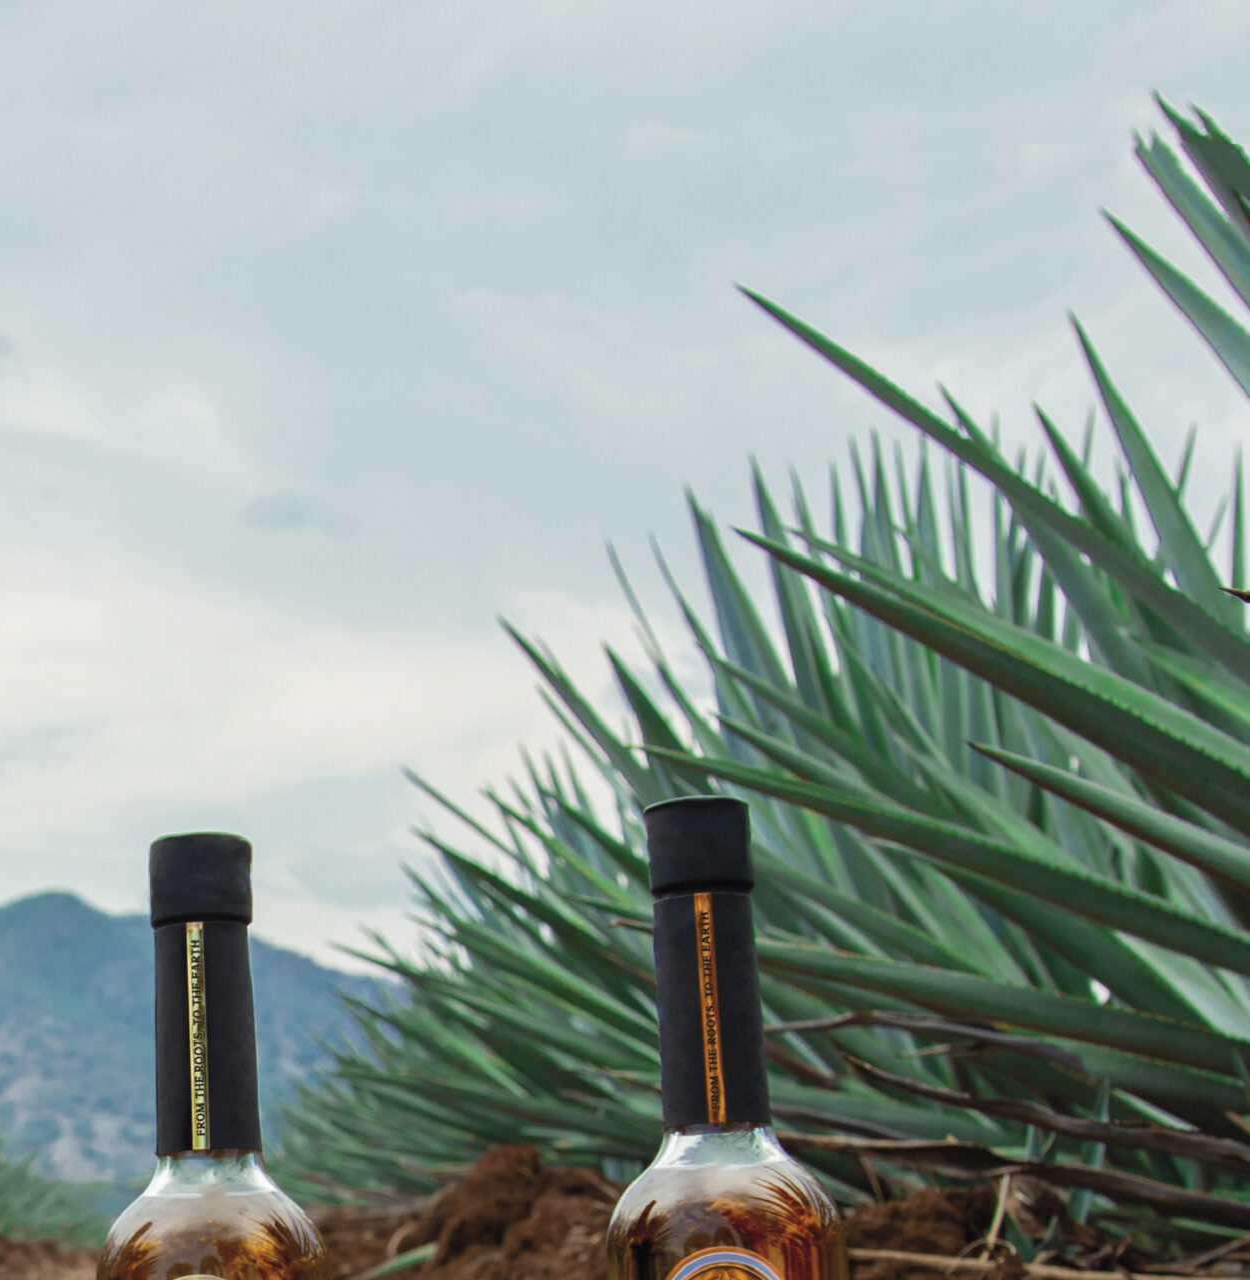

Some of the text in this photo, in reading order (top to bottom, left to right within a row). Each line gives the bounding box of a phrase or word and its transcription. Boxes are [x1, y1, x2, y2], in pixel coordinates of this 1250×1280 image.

[701, 912, 710, 951] EARTH
[190, 940, 200, 979] EARTH
[703, 956, 712, 978] THE
[191, 984, 201, 1006] THE
[705, 982, 714, 997] TO
[193, 1011, 202, 1026] TO
[709, 1050, 718, 1072] THE
[195, 1077, 204, 1098] THE
[710, 1076, 720, 1110] FROM
[196, 1103, 205, 1136] FROM
